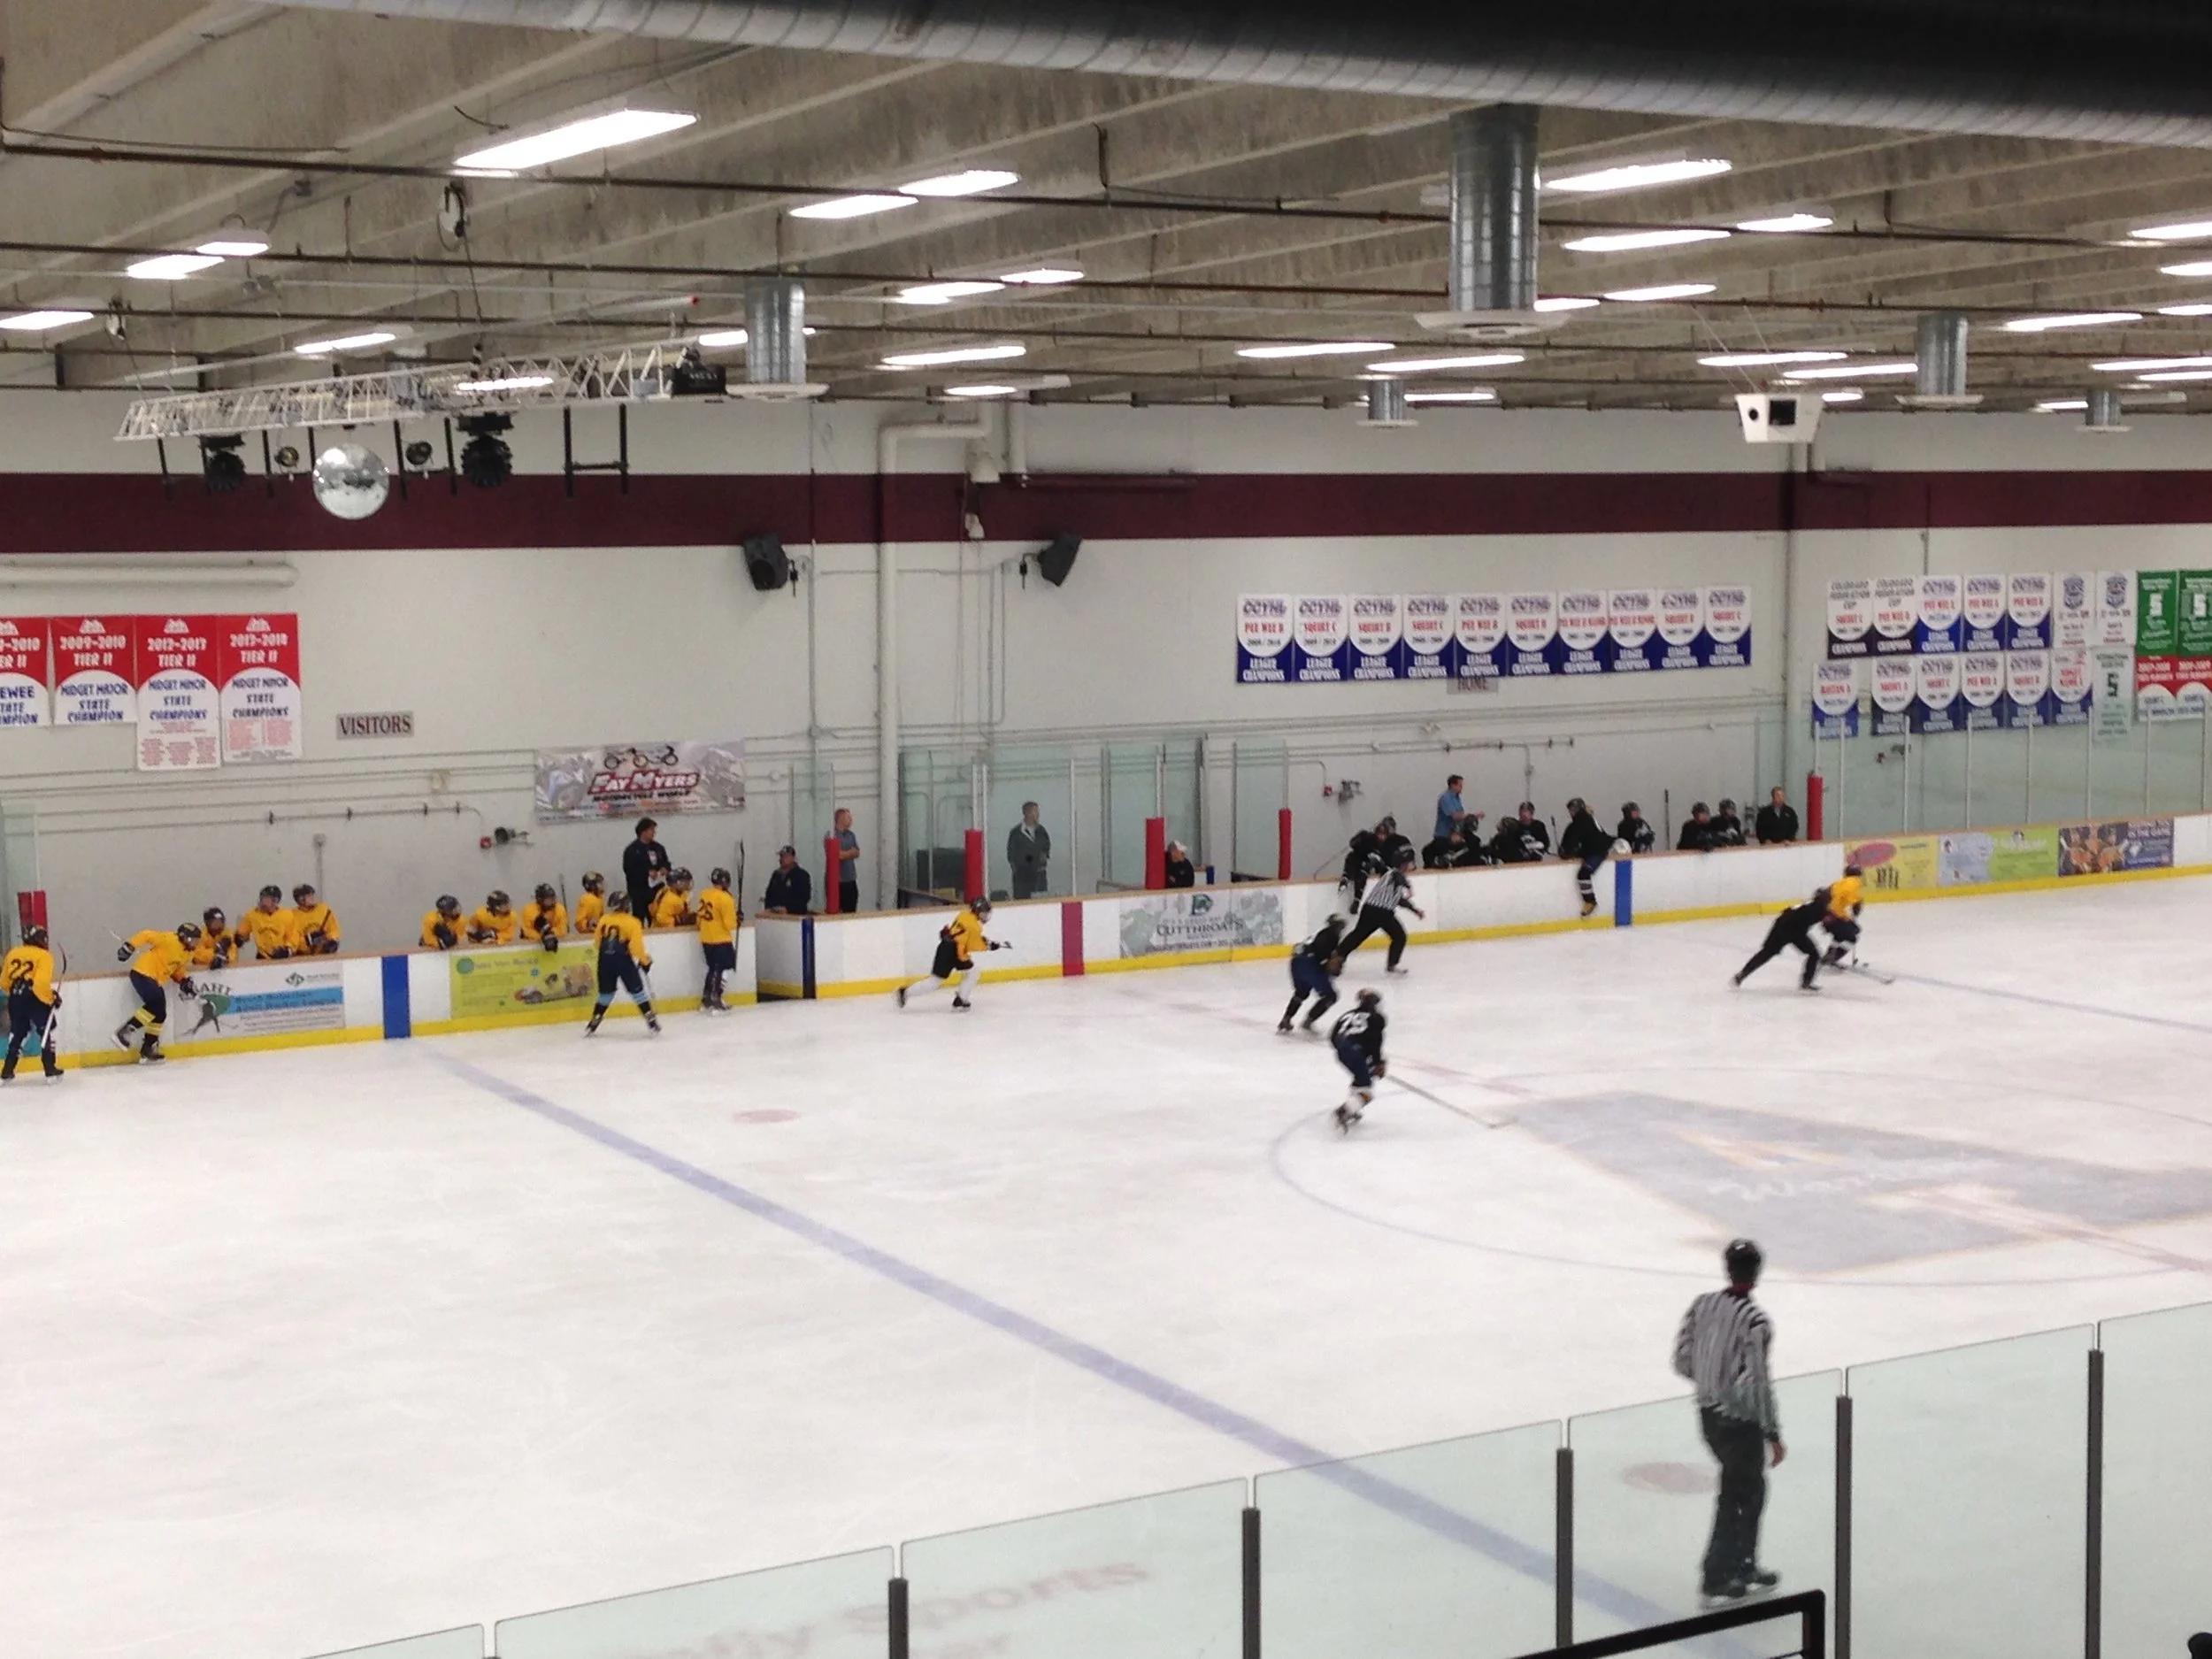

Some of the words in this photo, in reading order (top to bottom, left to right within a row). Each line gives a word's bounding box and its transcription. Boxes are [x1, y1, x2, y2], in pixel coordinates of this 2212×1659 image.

[73, 651, 100, 667] TIER
[158, 653, 184, 668] TIER
[241, 649, 265, 664] TIER
[96, 683, 128, 695] MAJOR
[79, 698, 111, 710] STATE
[163, 695, 192, 707] STATE
[246, 693, 275, 704] STATE
[68, 710, 124, 722] CHAMPION
[149, 709, 208, 721] CHAMPIONS
[232, 707, 289, 719] CHAMPIONS
[339, 714, 411, 735] VISITORS
[590, 774, 631, 793] FAY
[628, 770, 698, 791] MYERS
[9, 958, 35, 985] 22
